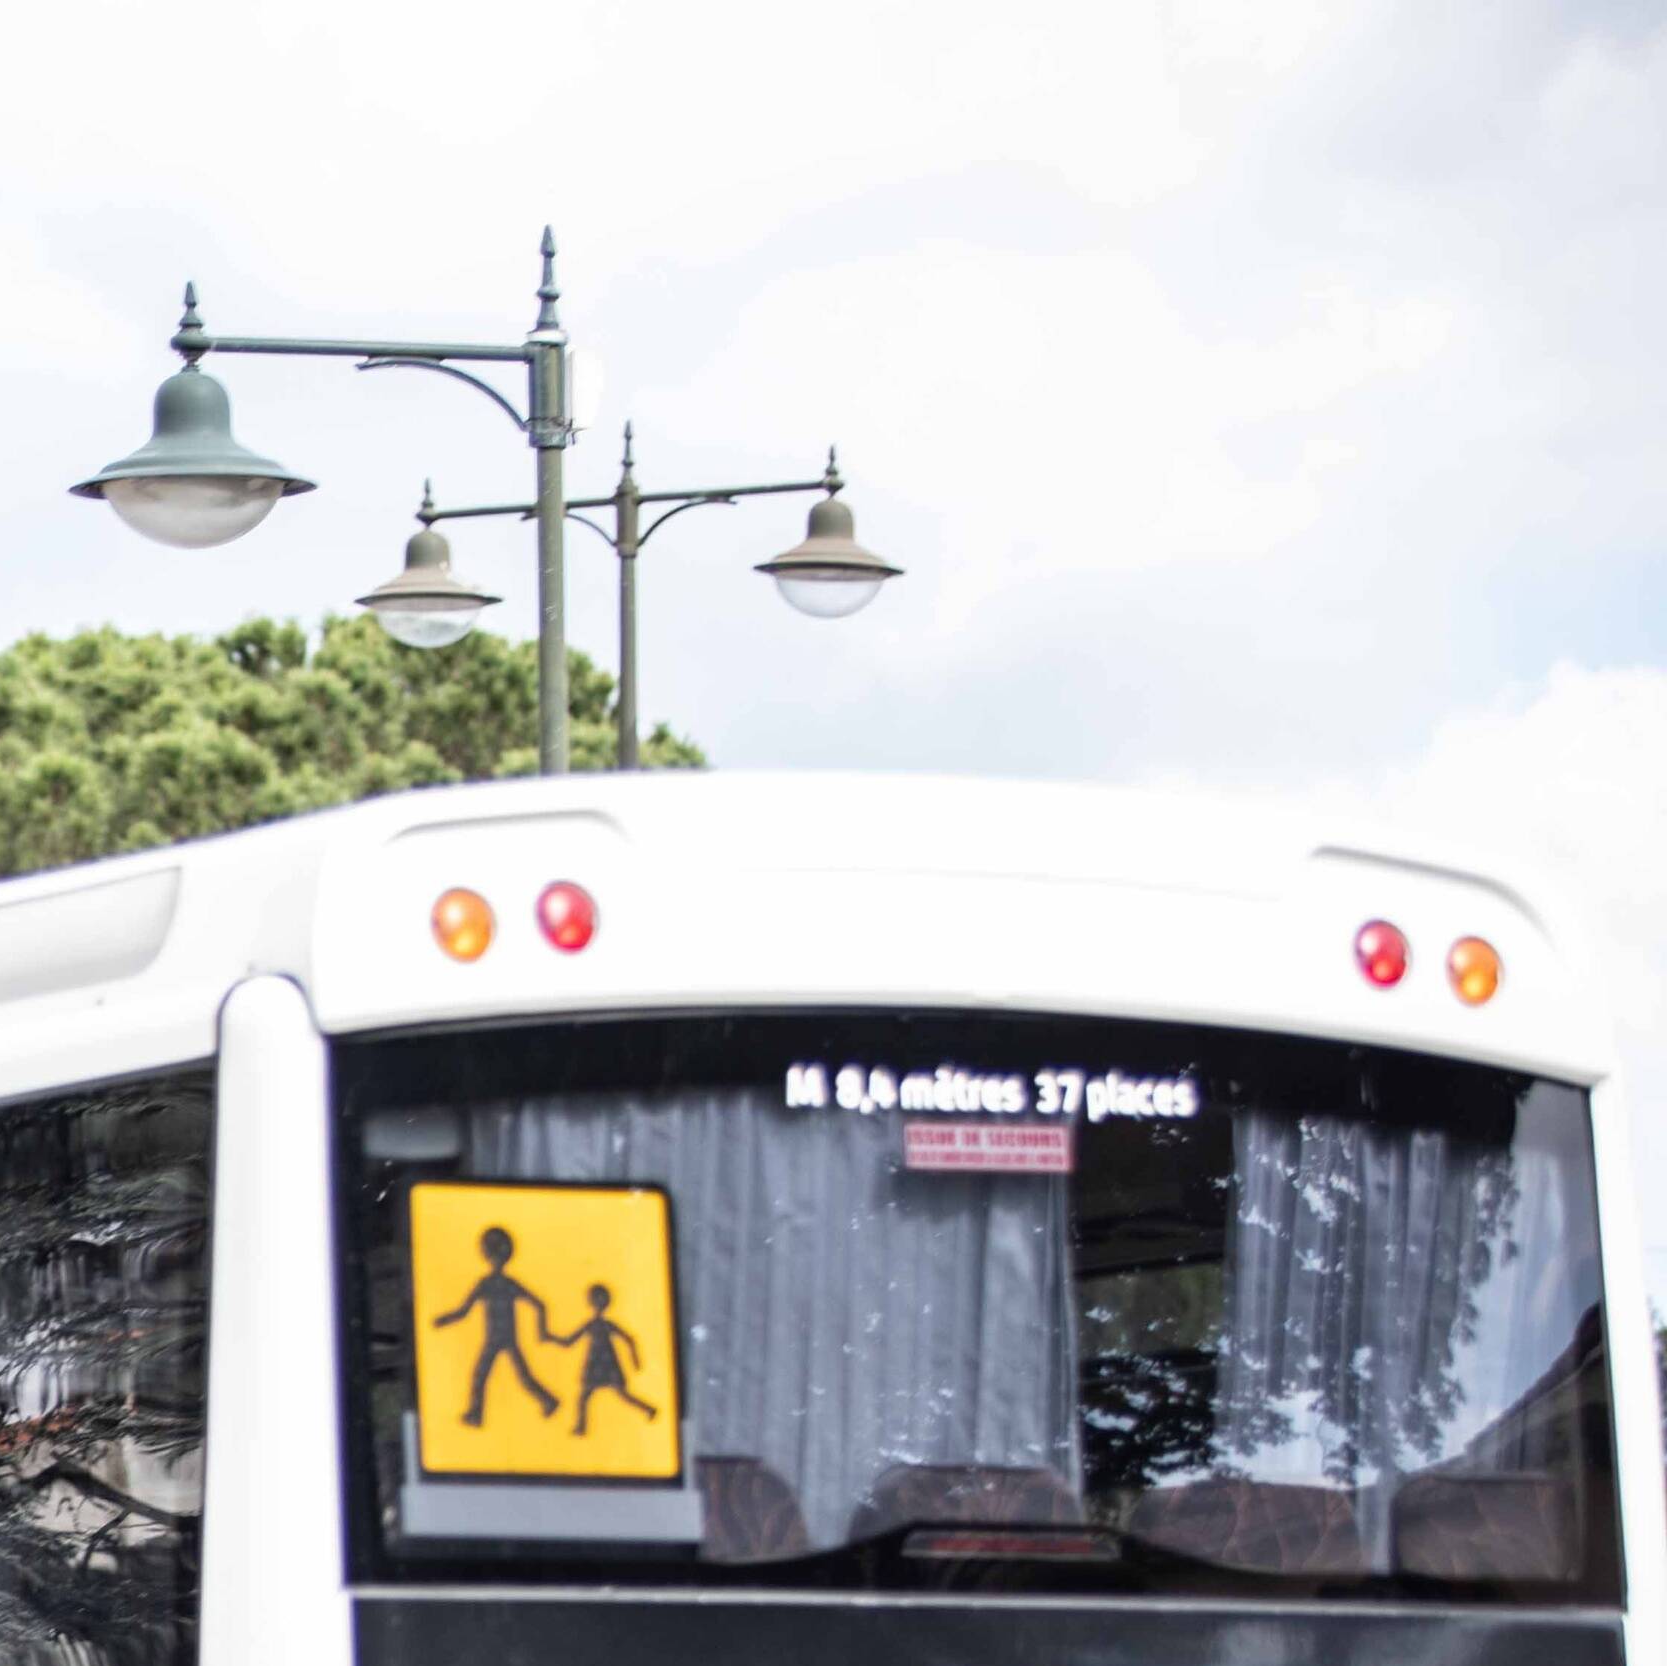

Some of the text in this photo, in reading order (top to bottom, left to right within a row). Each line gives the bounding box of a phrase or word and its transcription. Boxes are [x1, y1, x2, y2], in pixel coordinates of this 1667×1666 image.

[786, 1064, 826, 1108] M
[1034, 1068, 1083, 1114] 37
[1086, 1070, 1198, 1123] places
